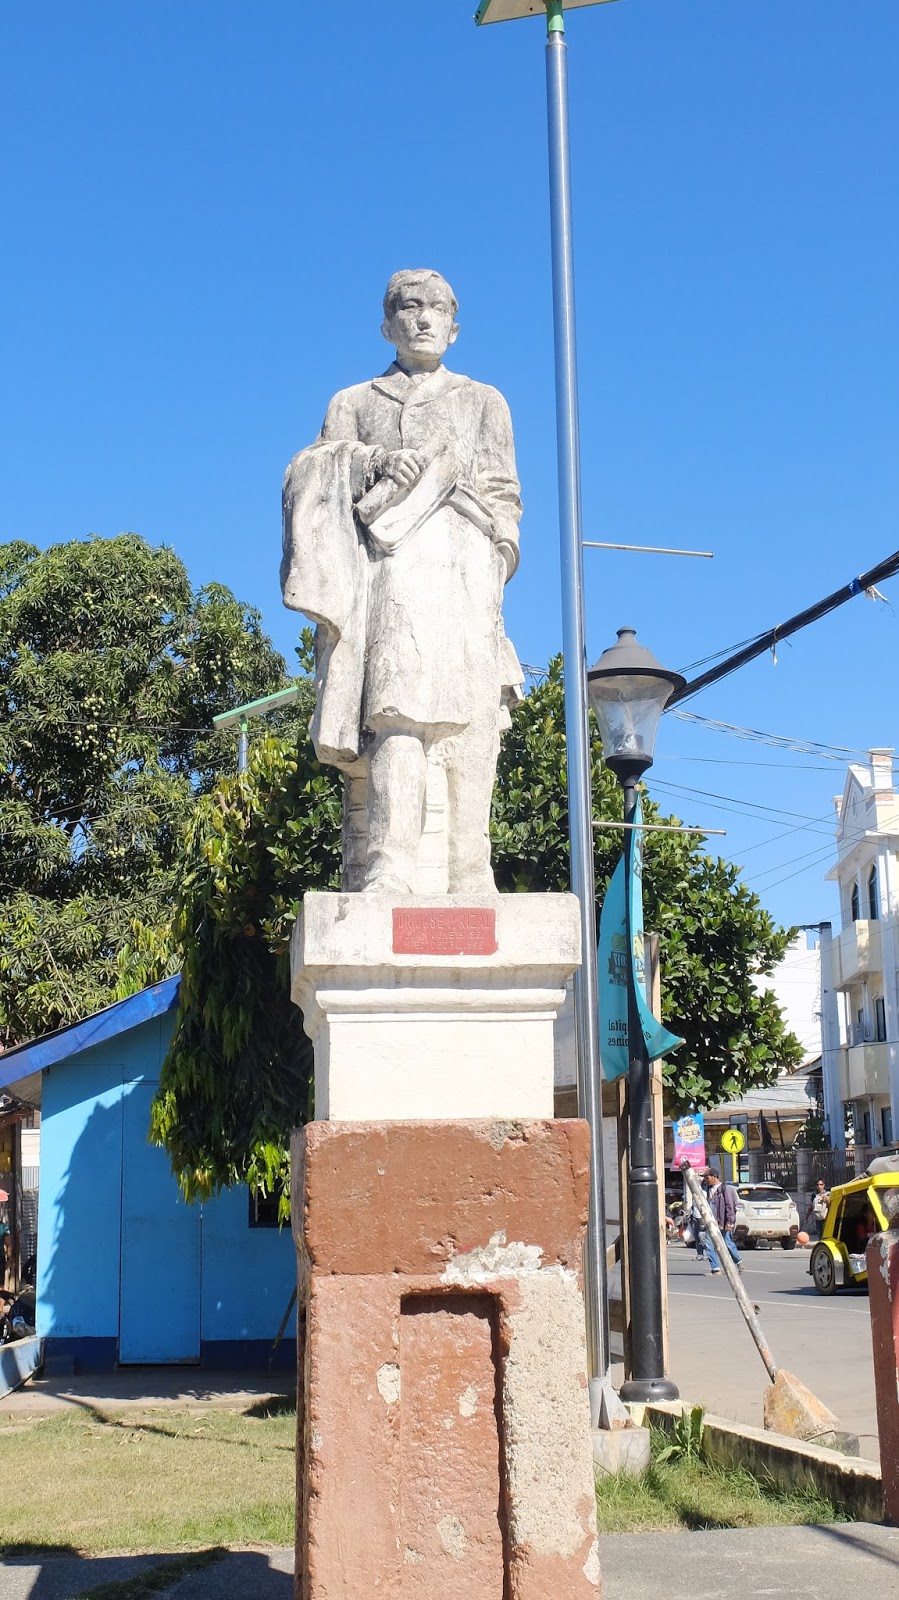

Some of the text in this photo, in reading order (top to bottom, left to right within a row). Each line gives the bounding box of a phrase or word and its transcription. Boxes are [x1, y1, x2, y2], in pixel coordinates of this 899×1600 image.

[416, 913, 444, 929] JOSE
[460, 913, 492, 929] RIZAL
[431, 931, 454, 940] JUNE
